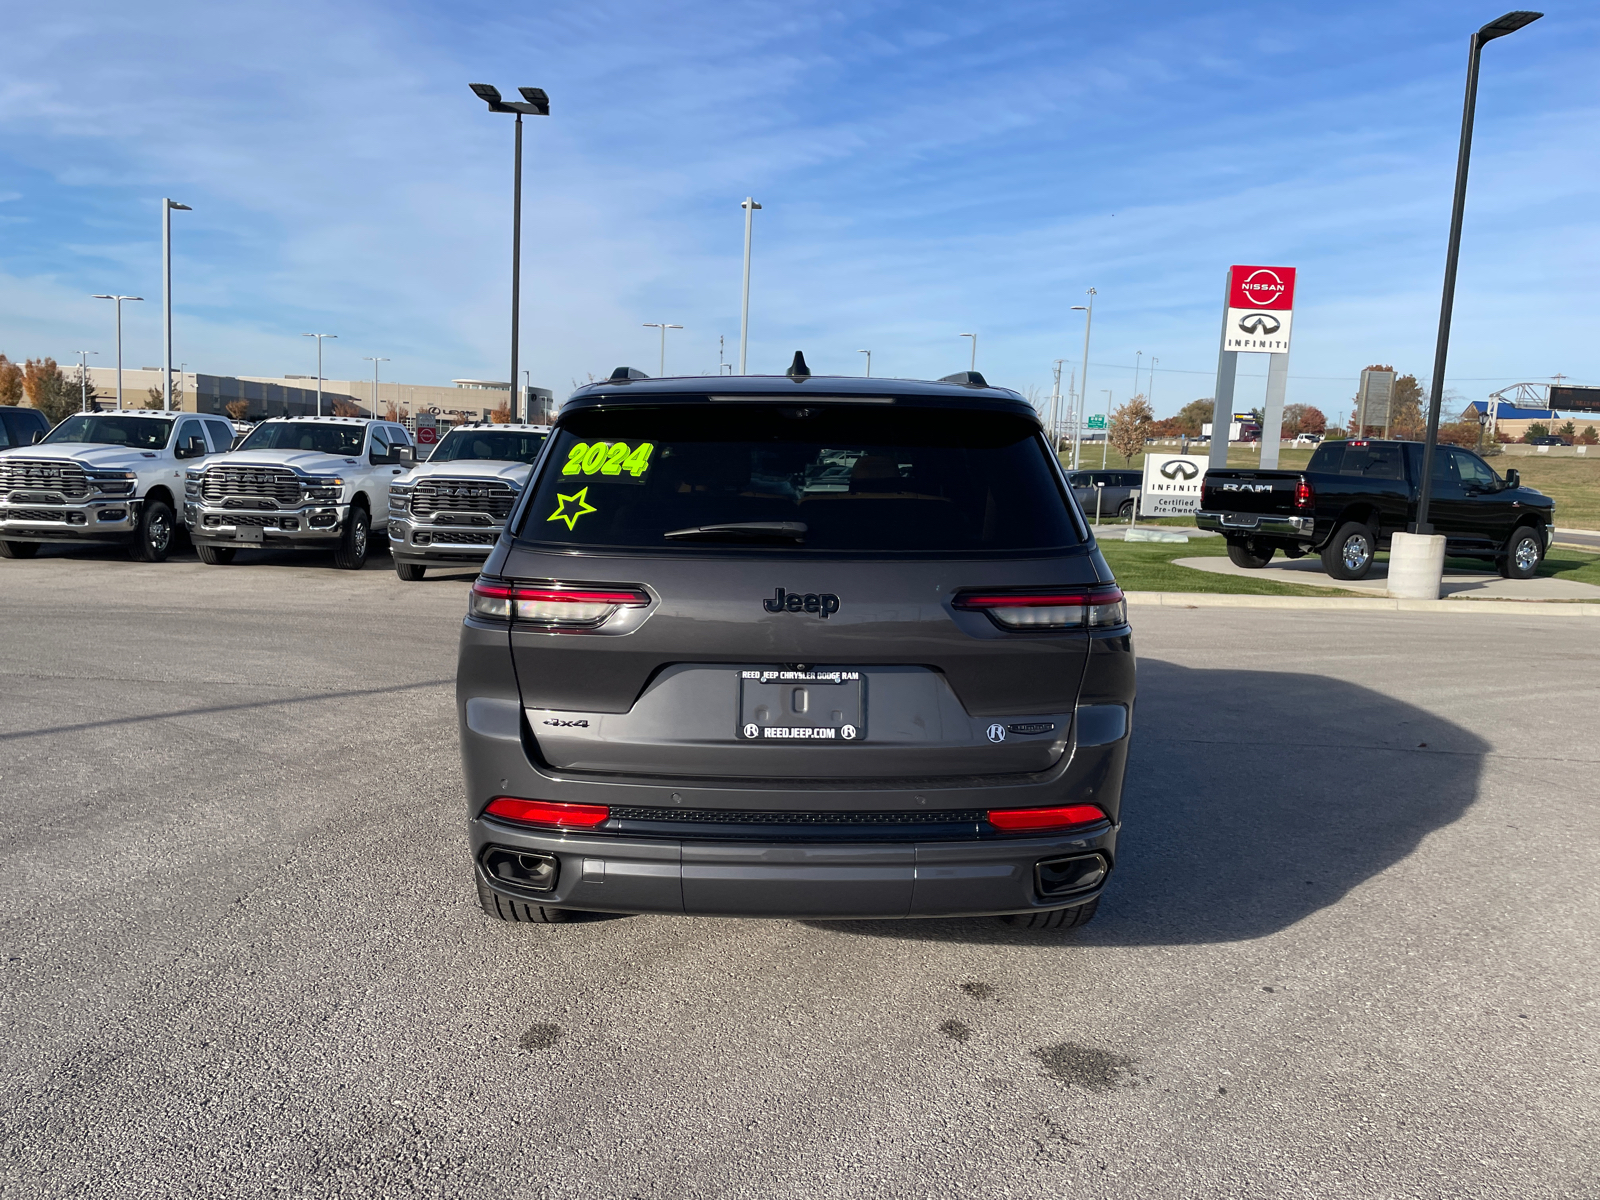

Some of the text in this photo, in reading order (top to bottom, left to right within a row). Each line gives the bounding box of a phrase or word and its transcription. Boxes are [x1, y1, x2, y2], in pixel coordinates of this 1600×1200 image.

[1241, 283, 1285, 291] NISSAN
[1228, 339, 1287, 349] INFINITI
[562, 442, 654, 477] 2024
[1152, 484, 1202, 493] INFINIT
[1223, 483, 1273, 494] RAM
[1154, 506, 1198, 514] Pre-Owned
[763, 587, 841, 619] Jeep
[742, 671, 859, 680] REED JEEP CHRYSLER DODGE RAM
[543, 718, 590, 728] 4x4
[764, 728, 835, 739] REEDJEEP.COM
